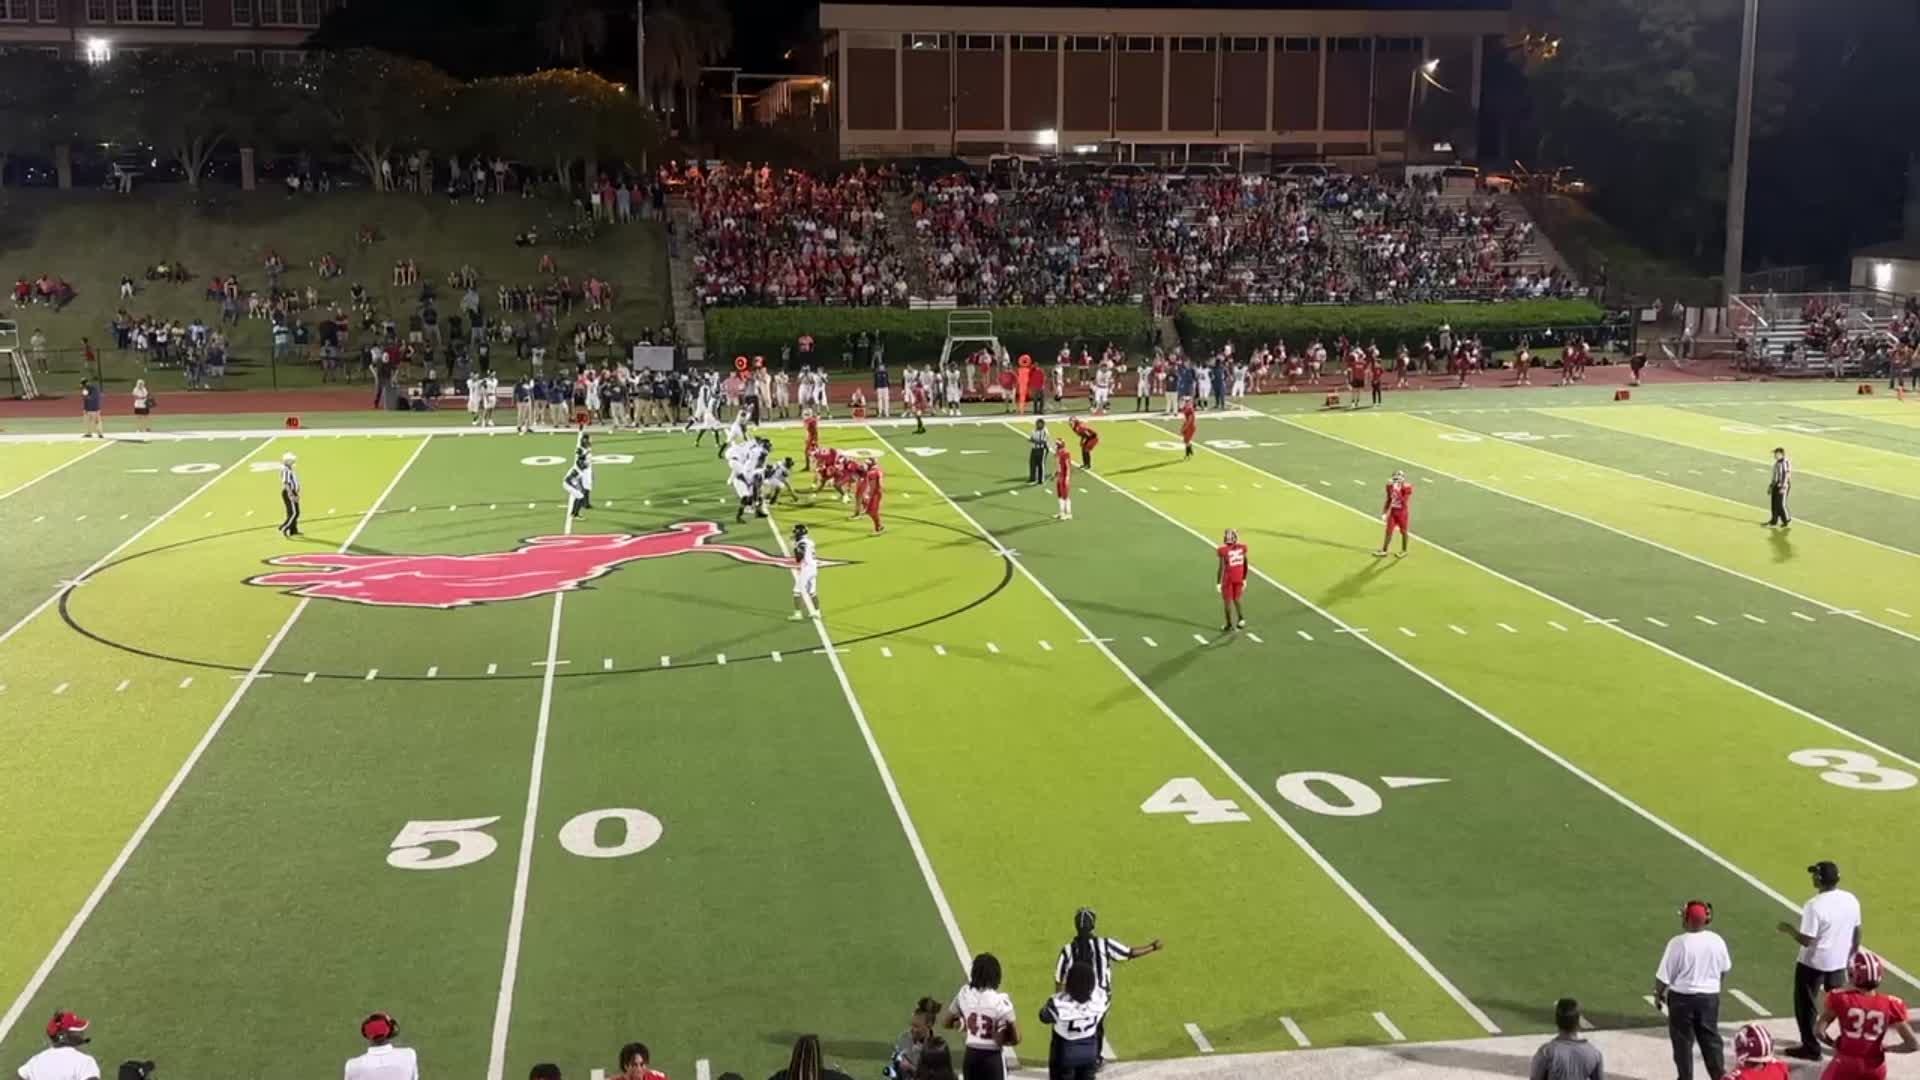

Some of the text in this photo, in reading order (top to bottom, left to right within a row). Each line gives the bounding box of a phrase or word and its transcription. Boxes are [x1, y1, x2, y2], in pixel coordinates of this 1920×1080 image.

[1788, 748, 1918, 790] 3
[966, 1011, 994, 1040] 43
[1847, 1007, 1886, 1041] 33
